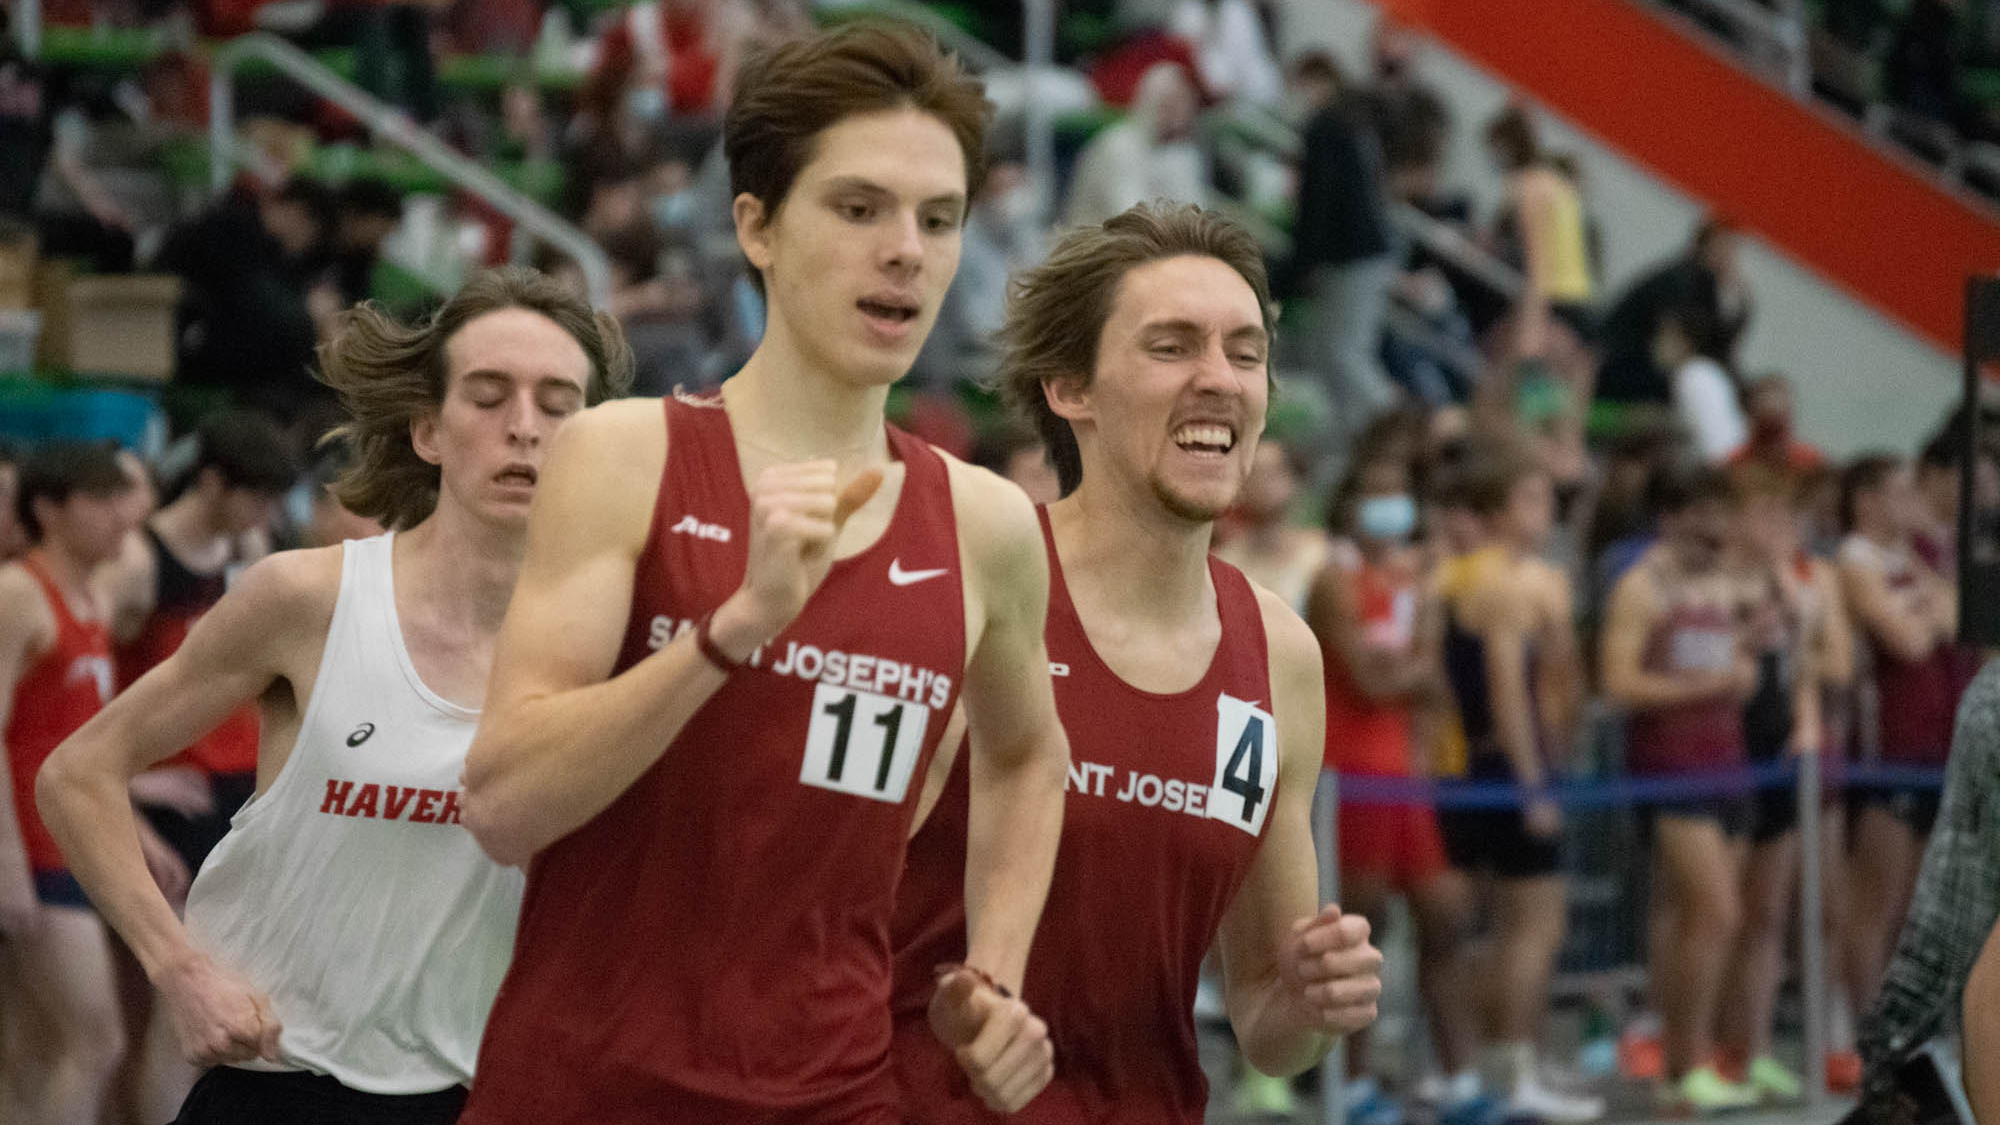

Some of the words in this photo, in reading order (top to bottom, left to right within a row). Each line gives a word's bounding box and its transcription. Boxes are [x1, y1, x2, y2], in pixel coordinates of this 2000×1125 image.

[773, 641, 951, 710] JOSEPH'S
[823, 693, 904, 792] 11
[1222, 715, 1265, 824] 4
[1116, 770, 1210, 819] JOSE
